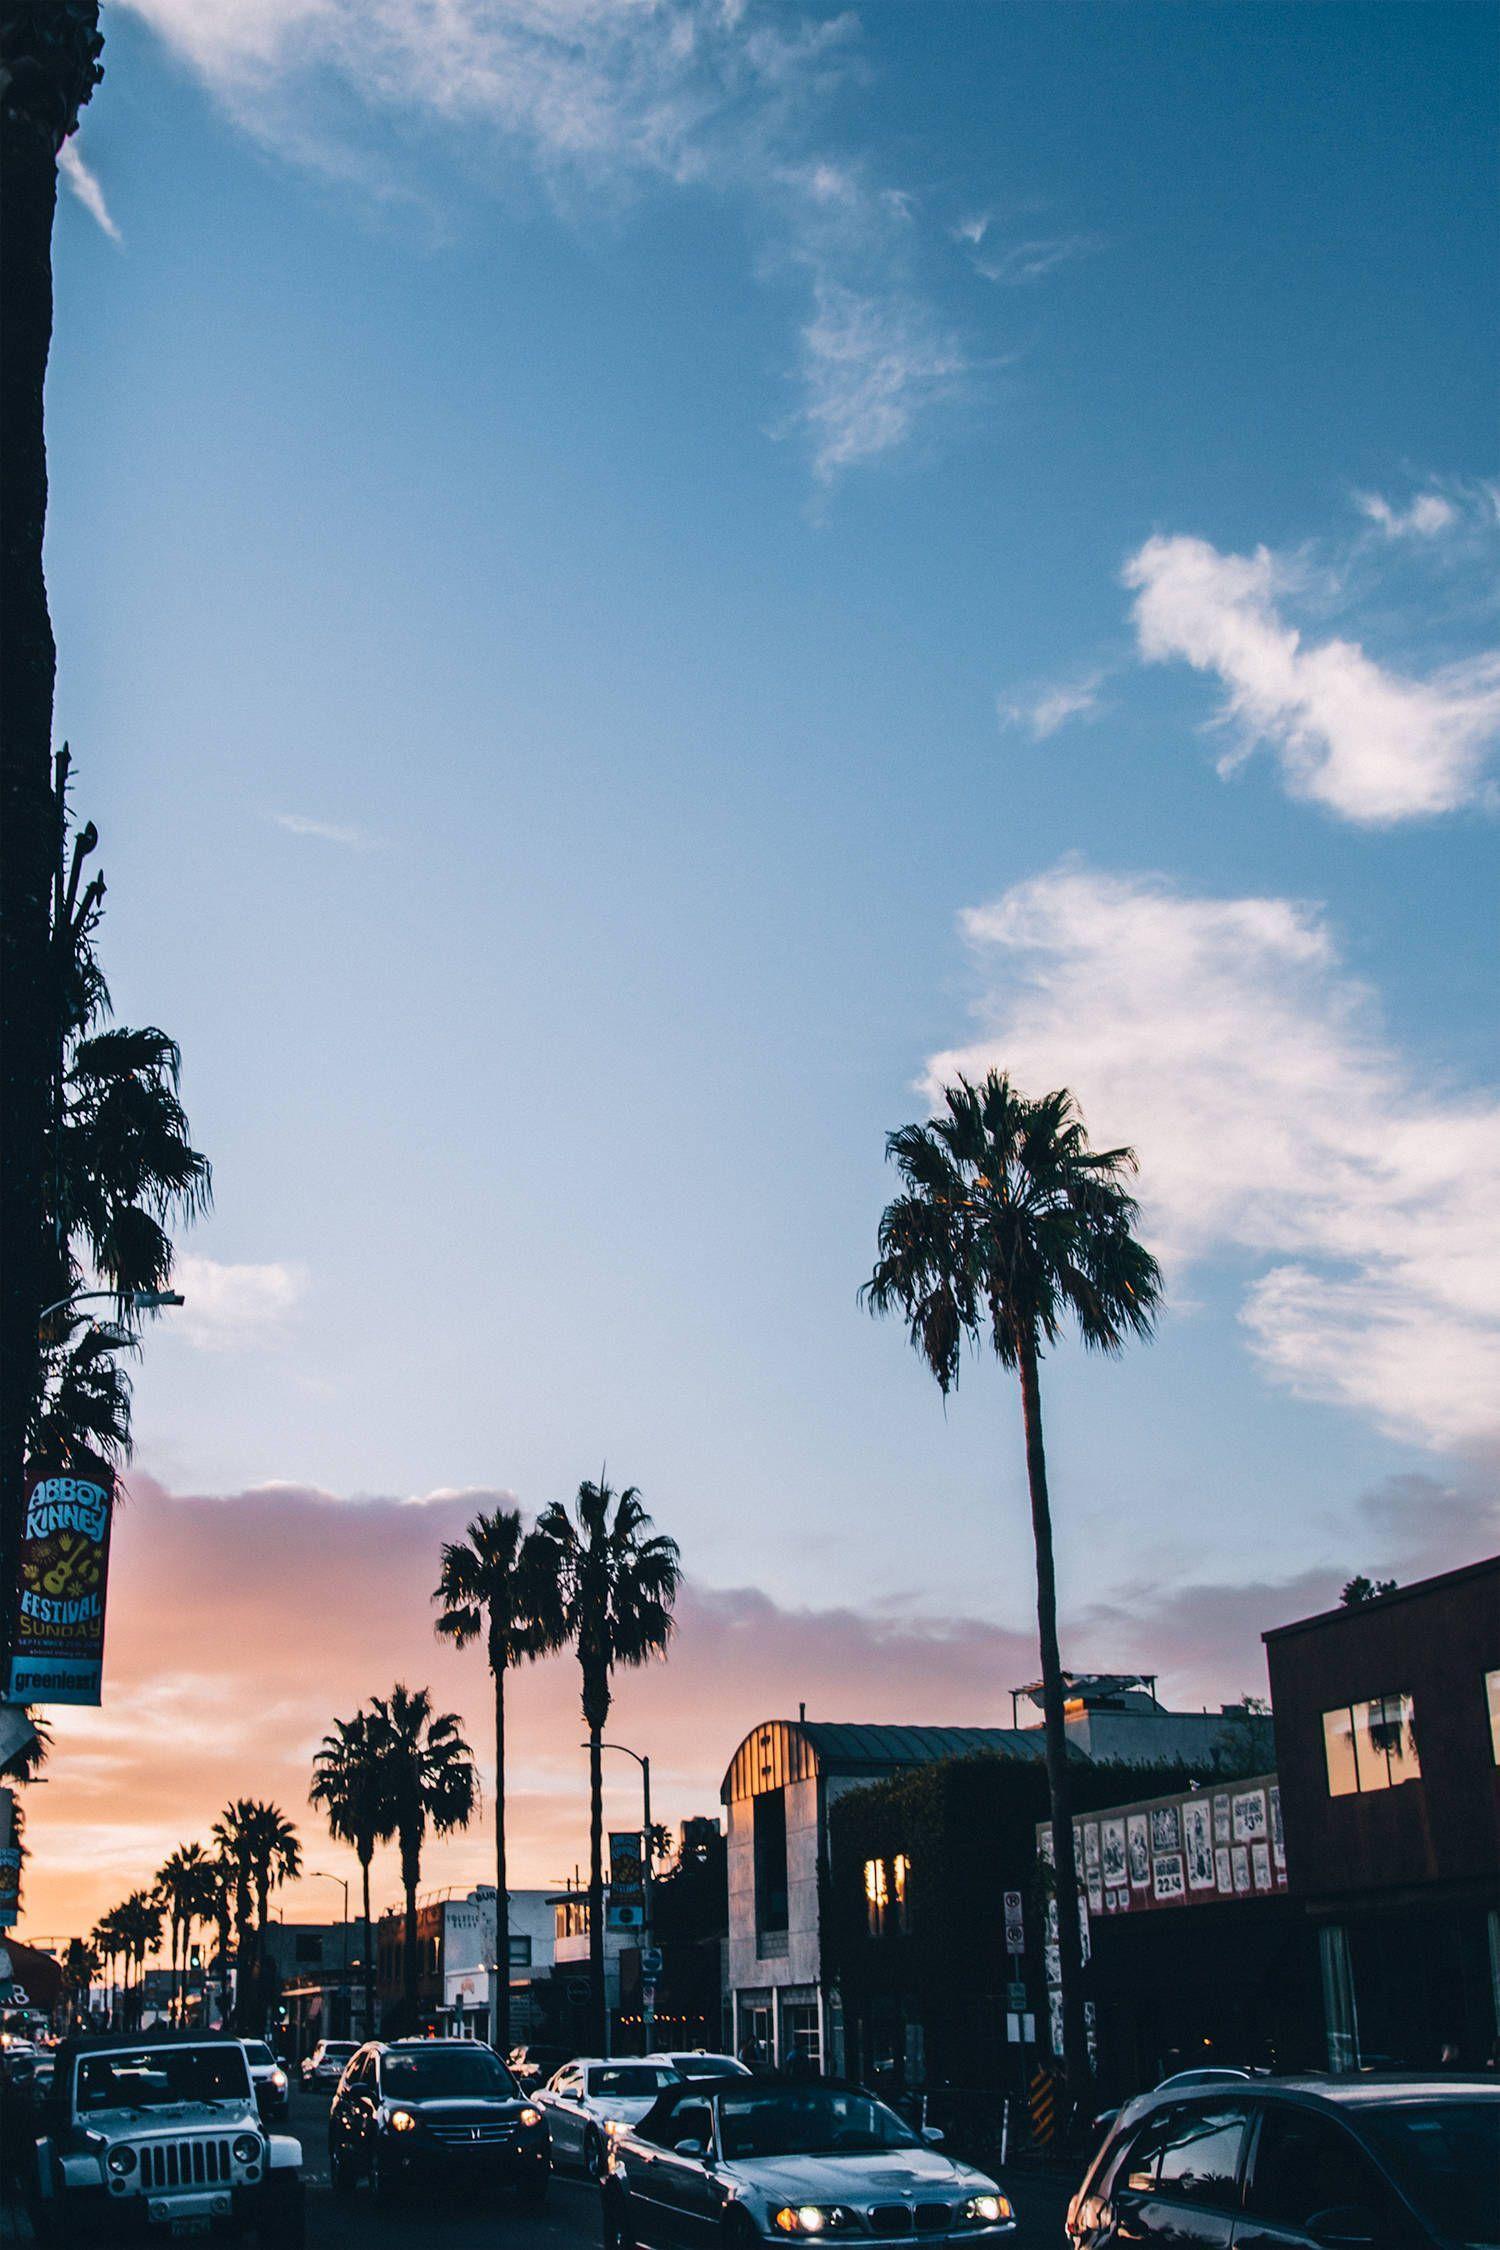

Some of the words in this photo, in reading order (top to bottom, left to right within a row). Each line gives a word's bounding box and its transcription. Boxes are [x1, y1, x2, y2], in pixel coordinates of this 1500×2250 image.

[28, 1477, 108, 1511] ABBOT
[26, 1504, 107, 1544] KINNEY
[21, 1590, 101, 1625] FESTIVAL
[20, 1615, 101, 1638] SUNDAY
